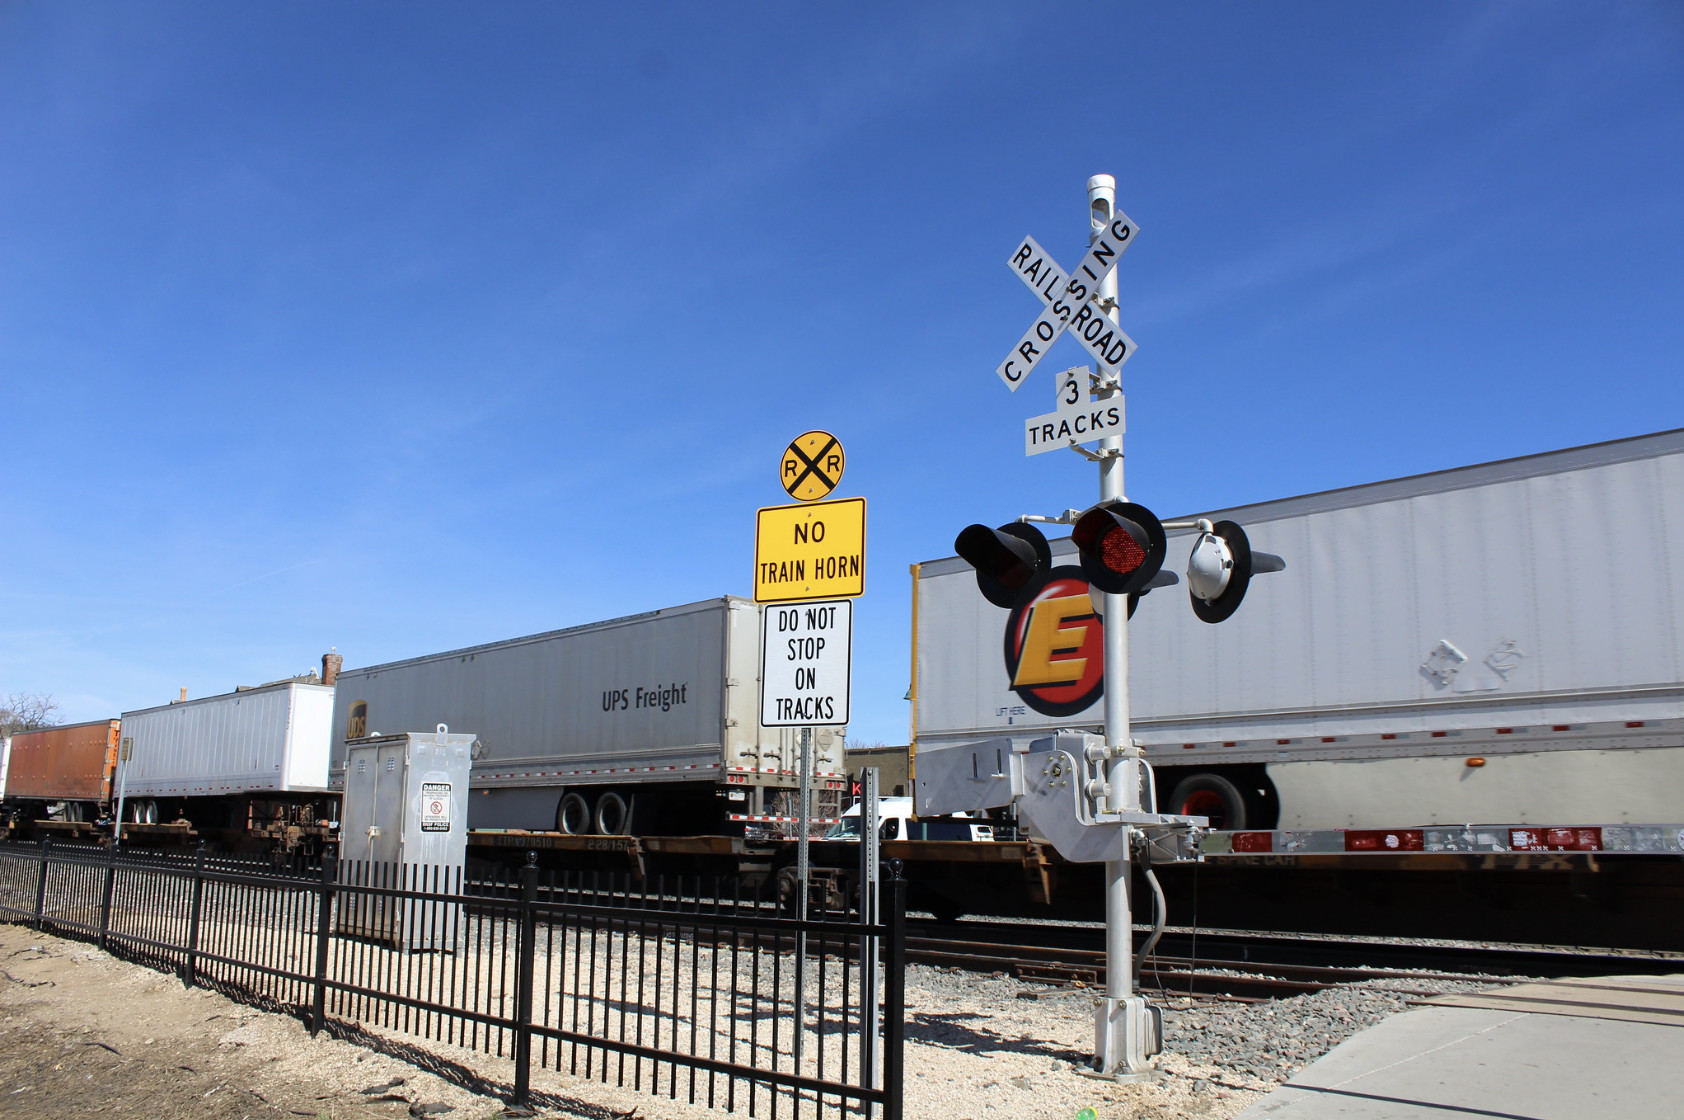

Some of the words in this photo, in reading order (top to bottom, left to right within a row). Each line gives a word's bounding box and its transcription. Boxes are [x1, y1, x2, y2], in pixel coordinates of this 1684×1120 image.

[1004, 219, 1131, 382] CROSSING
[1012, 242, 1060, 302] RAIL
[1070, 303, 1127, 366] ROAD
[1065, 379, 1079, 405] 3
[1028, 406, 1120, 446] TRACKS
[794, 520, 826, 545] NO
[760, 559, 805, 585] TRAIN
[815, 554, 860, 580] HORN
[778, 609, 799, 632] DO
[806, 606, 837, 631] NOT
[787, 637, 826, 661] STOP
[795, 667, 816, 691] ON
[602, 688, 629, 712] UPS
[635, 682, 687, 712] Freight
[775, 695, 834, 721] TRACKS
[1009, 705, 1026, 716] HERE
